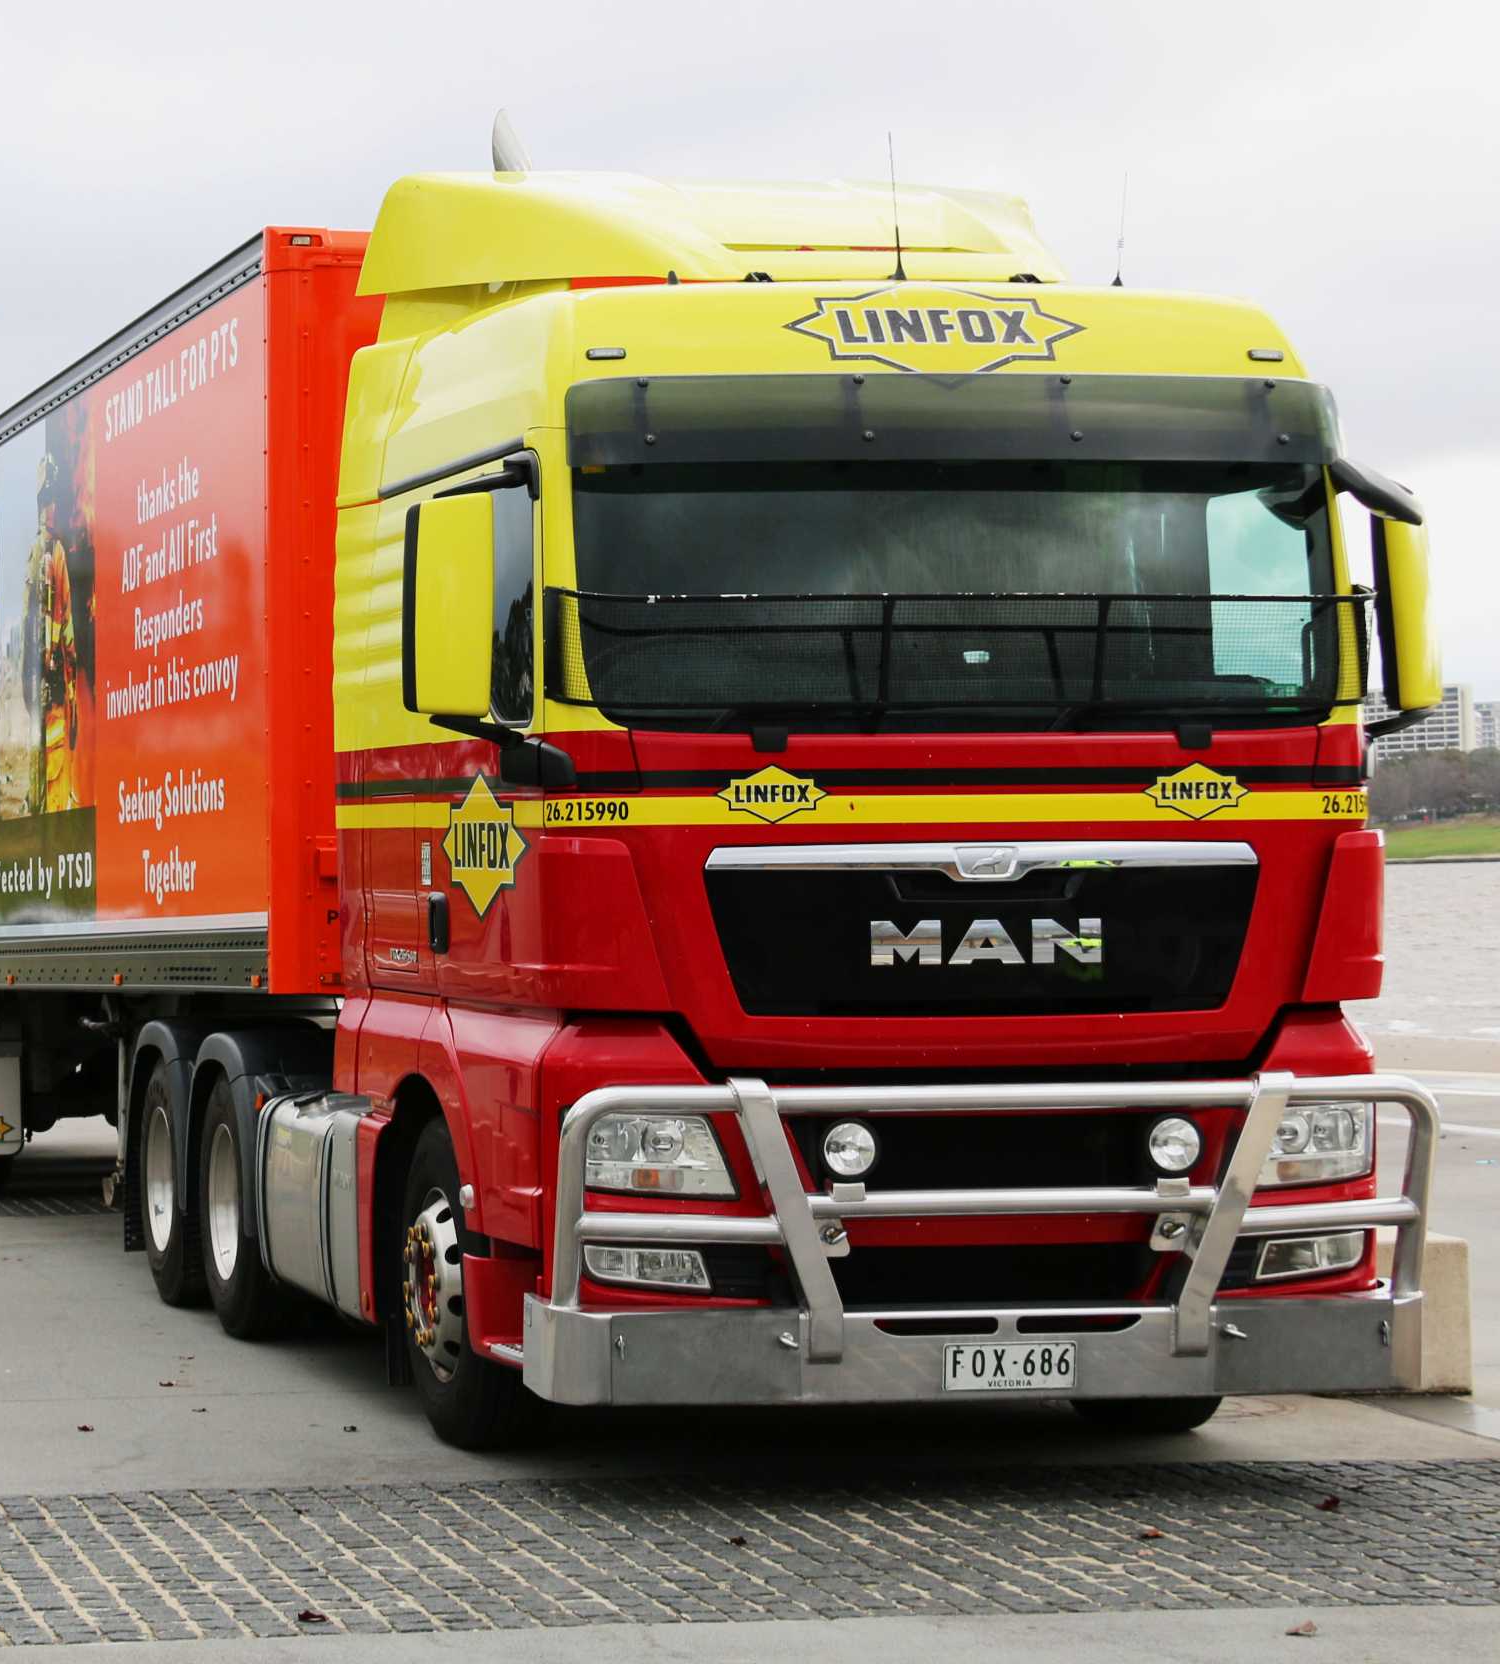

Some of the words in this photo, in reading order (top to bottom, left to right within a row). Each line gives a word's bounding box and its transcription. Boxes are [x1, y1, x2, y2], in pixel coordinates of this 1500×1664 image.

[835, 309, 1036, 344] LINFOX
[105, 380, 143, 442] STAND
[147, 359, 176, 416] TALL
[180, 338, 206, 396] FOR
[210, 318, 238, 378] PTS
[137, 467, 175, 524] thanks
[178, 455, 199, 504] the
[121, 543, 144, 594] ADF
[145, 532, 166, 585] and
[168, 523, 185, 575] All
[187, 512, 217, 567] First
[134, 589, 203, 656] Responders
[107, 664, 151, 720] involved
[153, 665, 164, 708] in
[167, 656, 190, 705] this
[193, 654, 238, 702] convoy
[118, 777, 162, 831] Seeking
[164, 768, 225, 818] Solutions
[546, 801, 629, 822] 26.215990
[734, 783, 810, 804] LINFOX
[1160, 781, 1232, 801] LINFOX
[453, 822, 510, 870] LINFOX
[38, 856, 53, 899] by
[58, 852, 93, 890] PTSD
[142, 845, 197, 905] Together
[870, 917, 1102, 966] MAN
[988, 1379, 1033, 1388] VICTORIA
